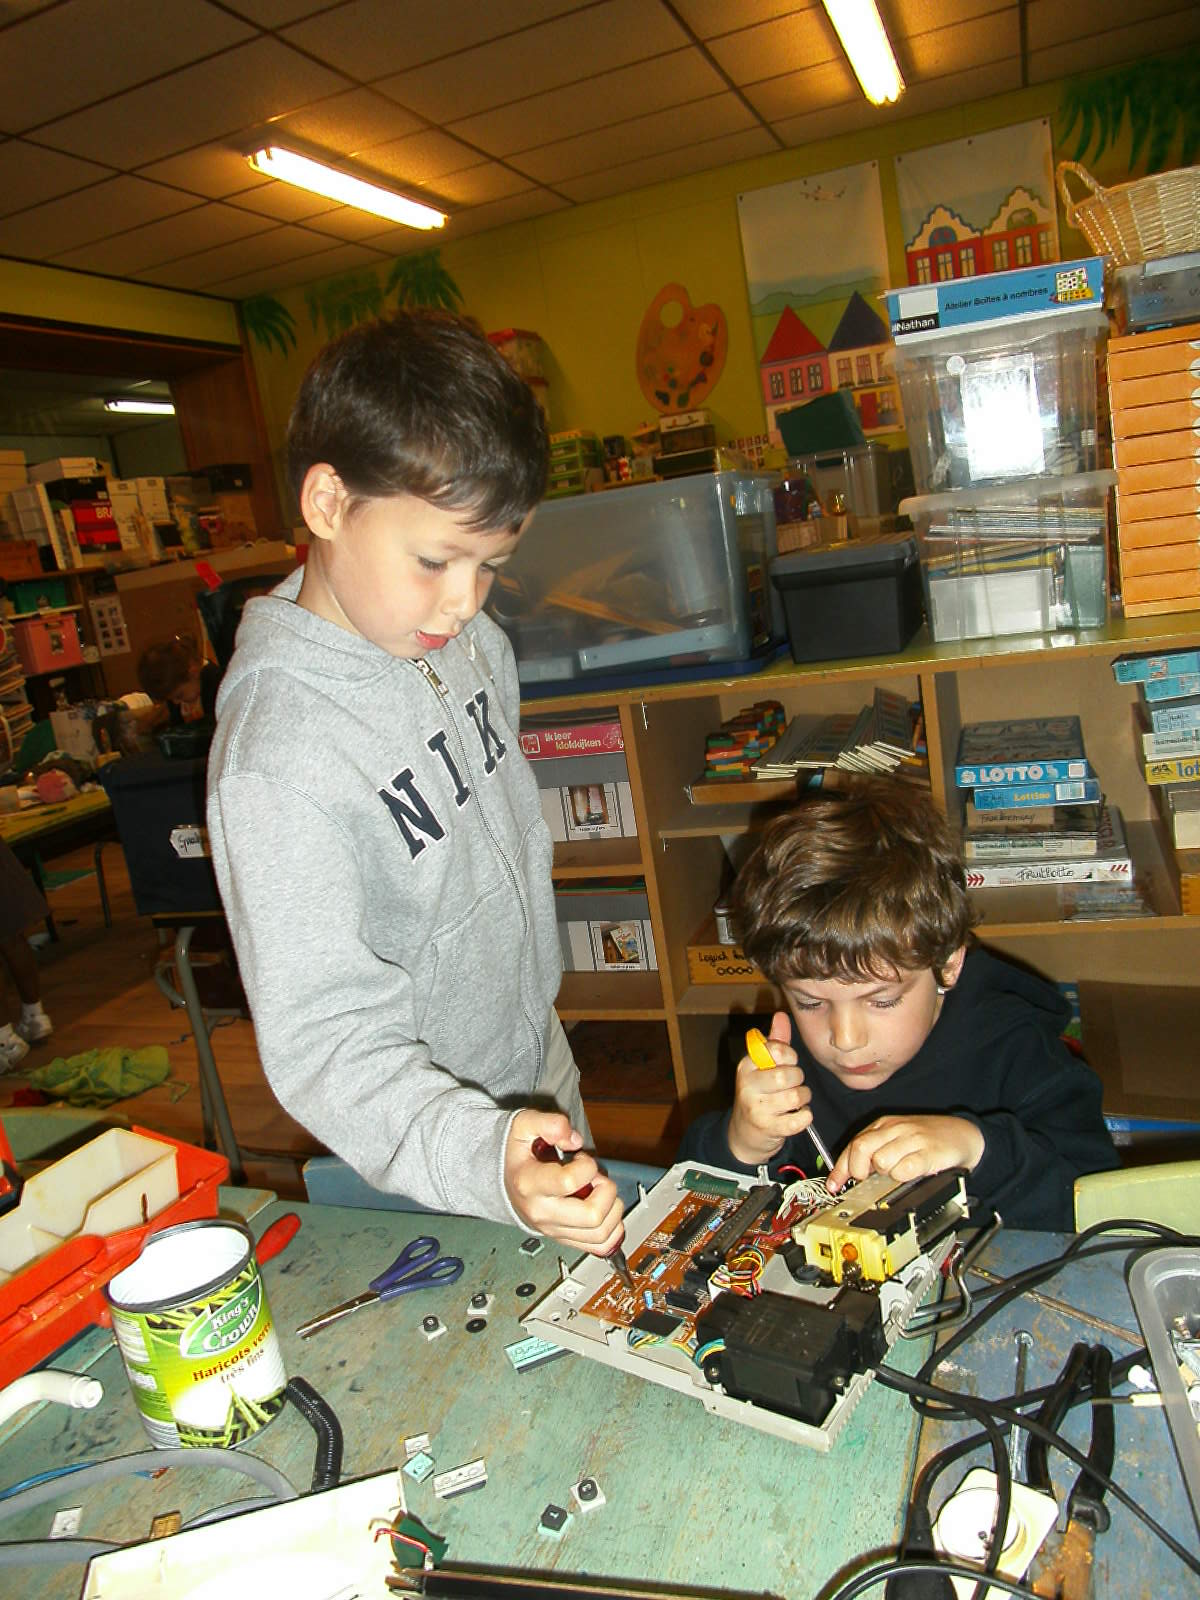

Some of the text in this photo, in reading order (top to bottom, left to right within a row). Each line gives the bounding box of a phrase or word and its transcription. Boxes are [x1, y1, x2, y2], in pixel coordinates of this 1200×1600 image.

[945, 301, 972, 311] Atelier
[1010, 287, 1048, 300] nombres
[897, 318, 935, 332] Nathan
[555, 739, 601, 751] klokkijken
[980, 765, 1044, 783] LOTTO
[212, 1296, 249, 1330] King's
[203, 1304, 258, 1351] Crown
[192, 1347, 251, 1382] Haricots
